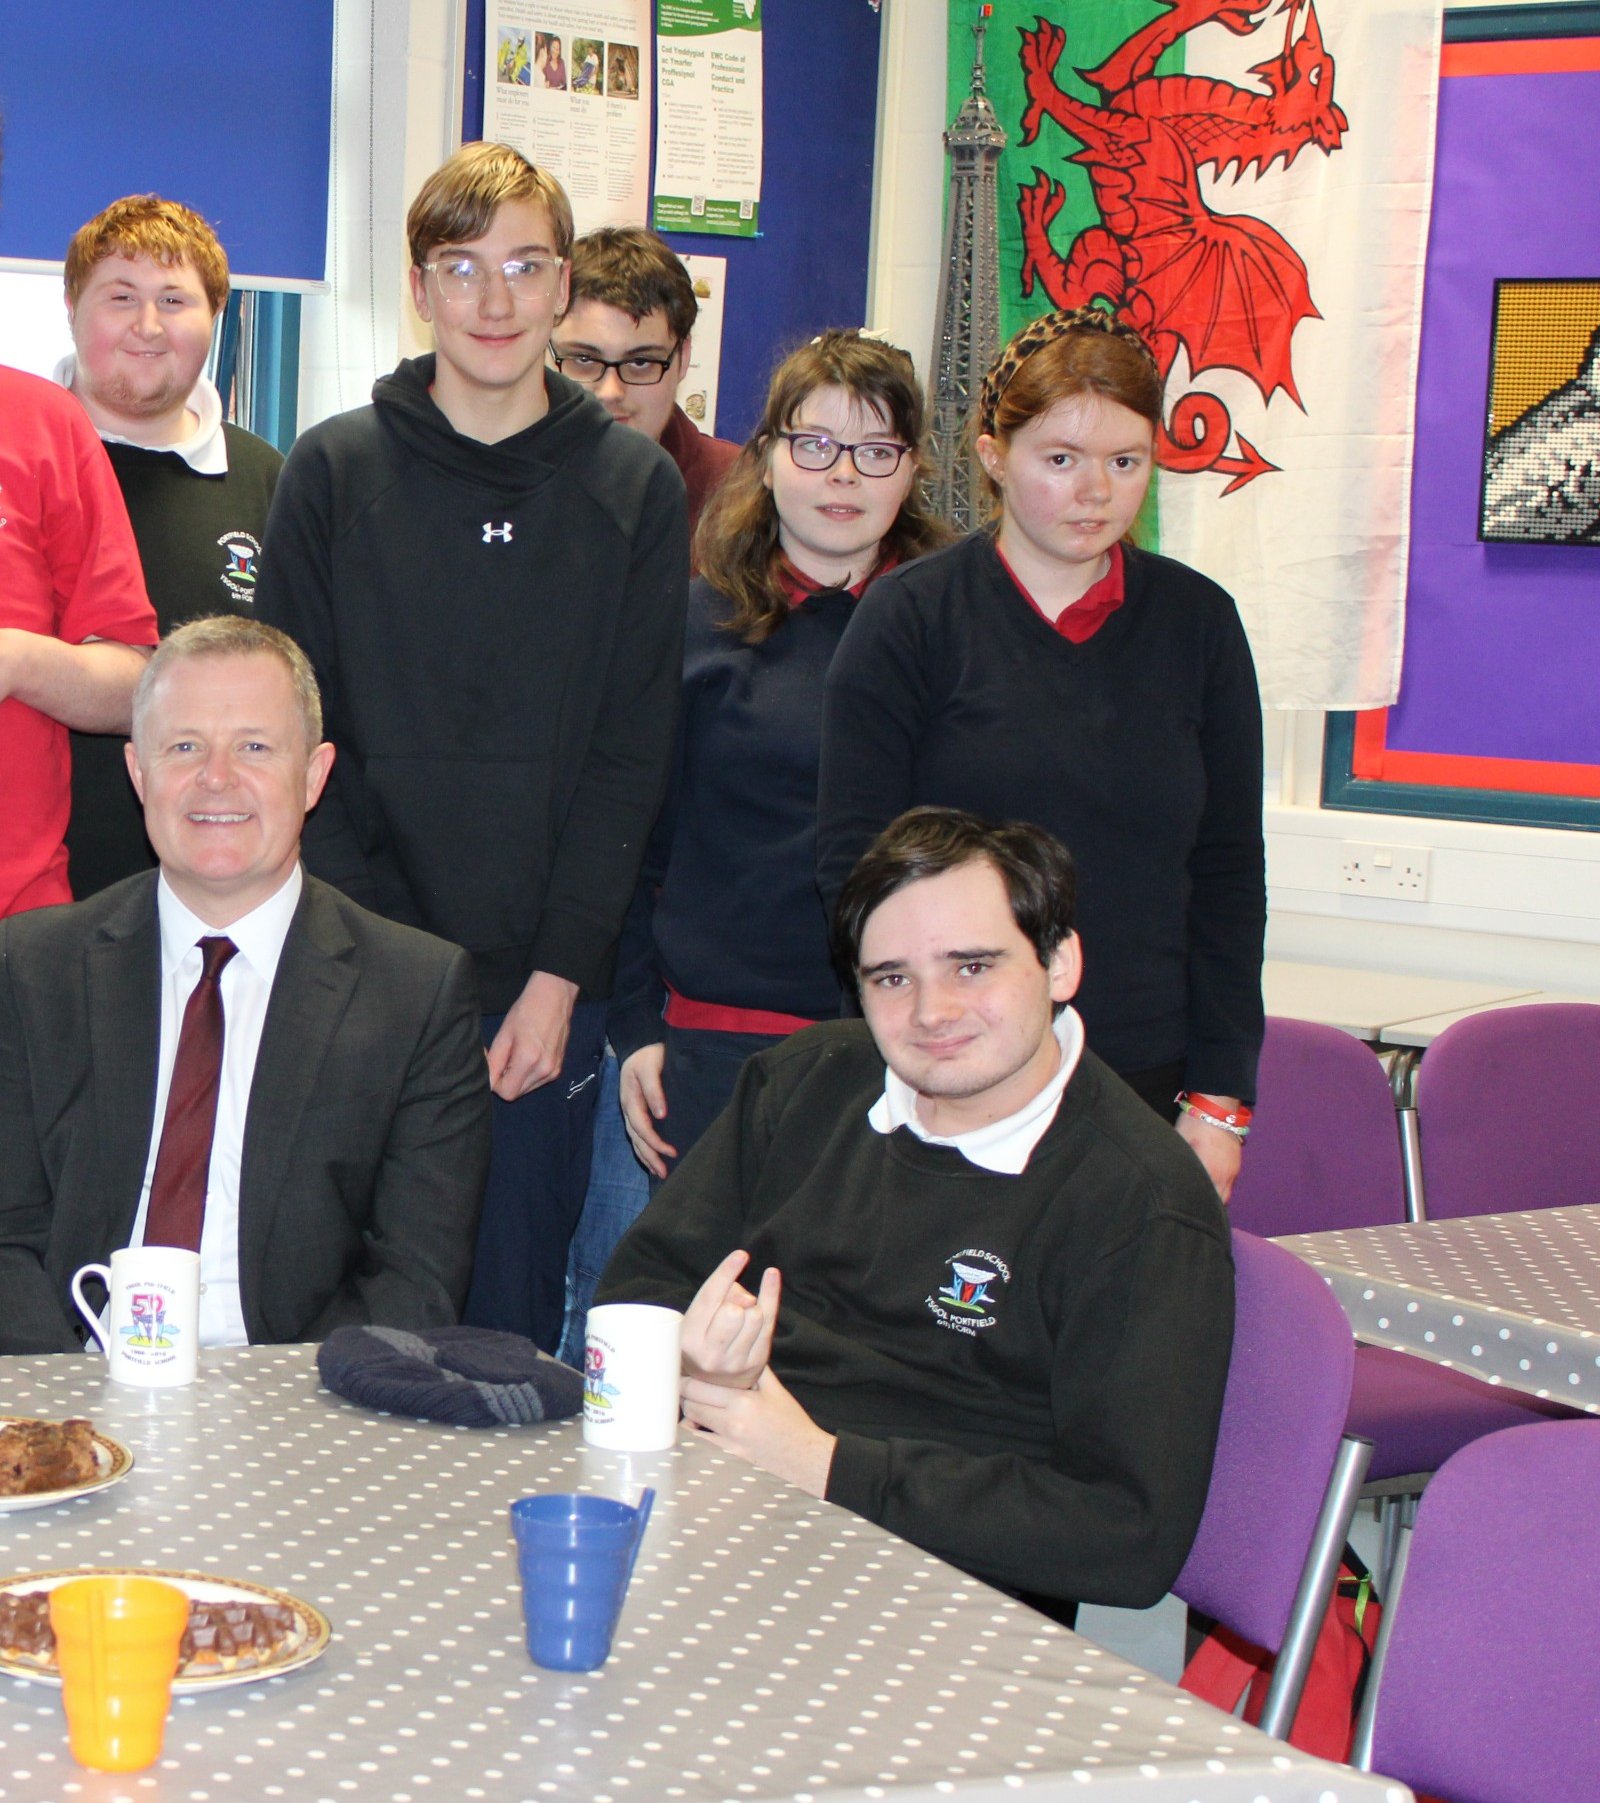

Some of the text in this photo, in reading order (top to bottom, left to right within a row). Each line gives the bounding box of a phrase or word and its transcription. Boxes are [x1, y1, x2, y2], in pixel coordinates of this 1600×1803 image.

[711, 63, 744, 73] Professional
[712, 74, 733, 83] Conduct
[712, 85, 734, 93] Practice
[984, 1252, 1012, 1283] SCHOOL
[131, 1294, 164, 1316] 50
[925, 1295, 996, 1328] YSGOL PORTFIELD
[951, 1322, 976, 1337] FORM
